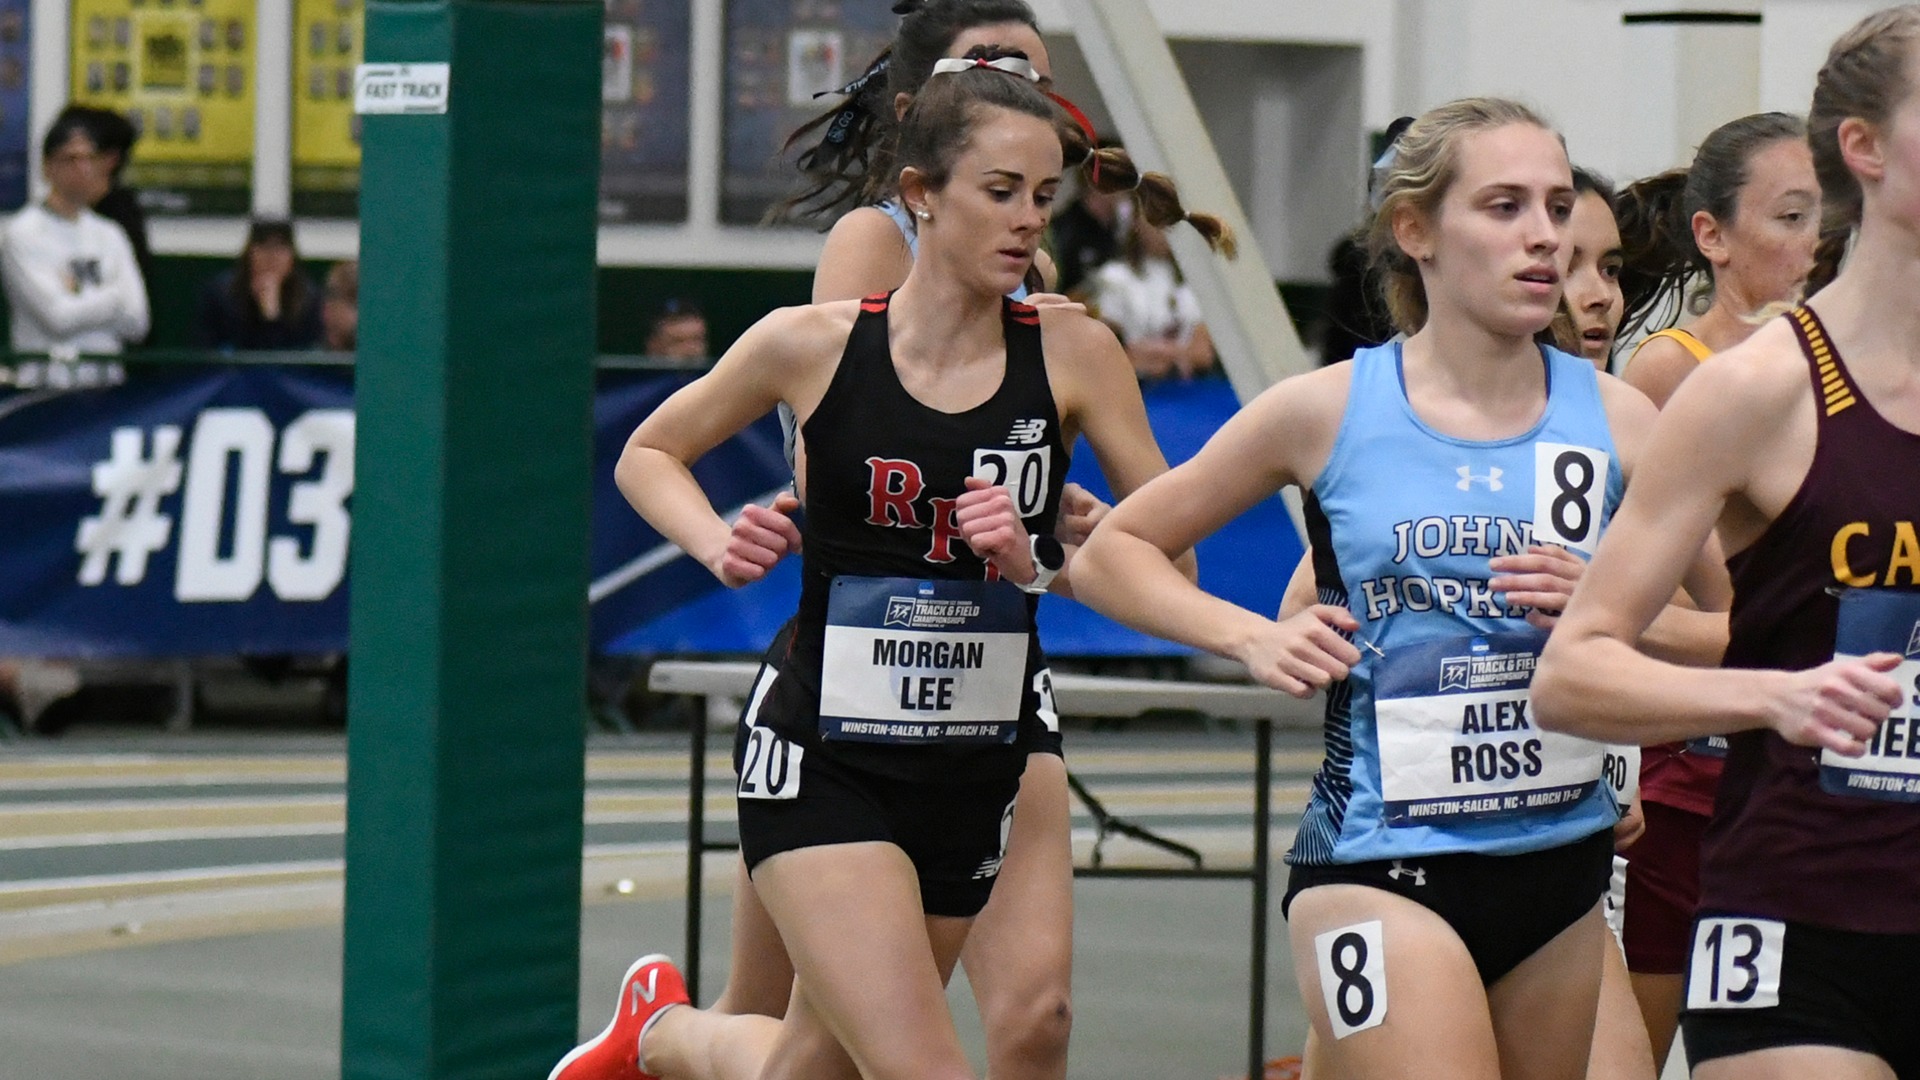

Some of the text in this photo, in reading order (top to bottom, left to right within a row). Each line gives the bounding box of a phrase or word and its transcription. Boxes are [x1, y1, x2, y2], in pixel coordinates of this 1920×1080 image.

[366, 83, 397, 98] FAST
[74, 409, 355, 601] #D3
[1550, 450, 1595, 543] 8
[1391, 514, 1566, 565] JOHN
[916, 604, 947, 616] TRACK
[955, 606, 980, 616] FIELD
[1361, 575, 1560, 621] HOPK
[872, 638, 984, 669] MORGAN
[1472, 661, 1506, 674] TRACK
[1516, 656, 1538, 671] FIEL
[900, 676, 954, 711] LEE
[841, 721, 999, 738] WINSTON-SALEM, NC MARCH 11-12
[1461, 699, 1530, 735] ALEX
[741, 730, 790, 796] 20
[1450, 739, 1543, 784] ROSS
[1408, 798, 1501, 817] WINSTON-SALEM,
[1503, 796, 1519, 809] NC
[1526, 791, 1562, 807] MARCH
[1331, 932, 1374, 1027] 8
[1705, 923, 1763, 1004] 13
